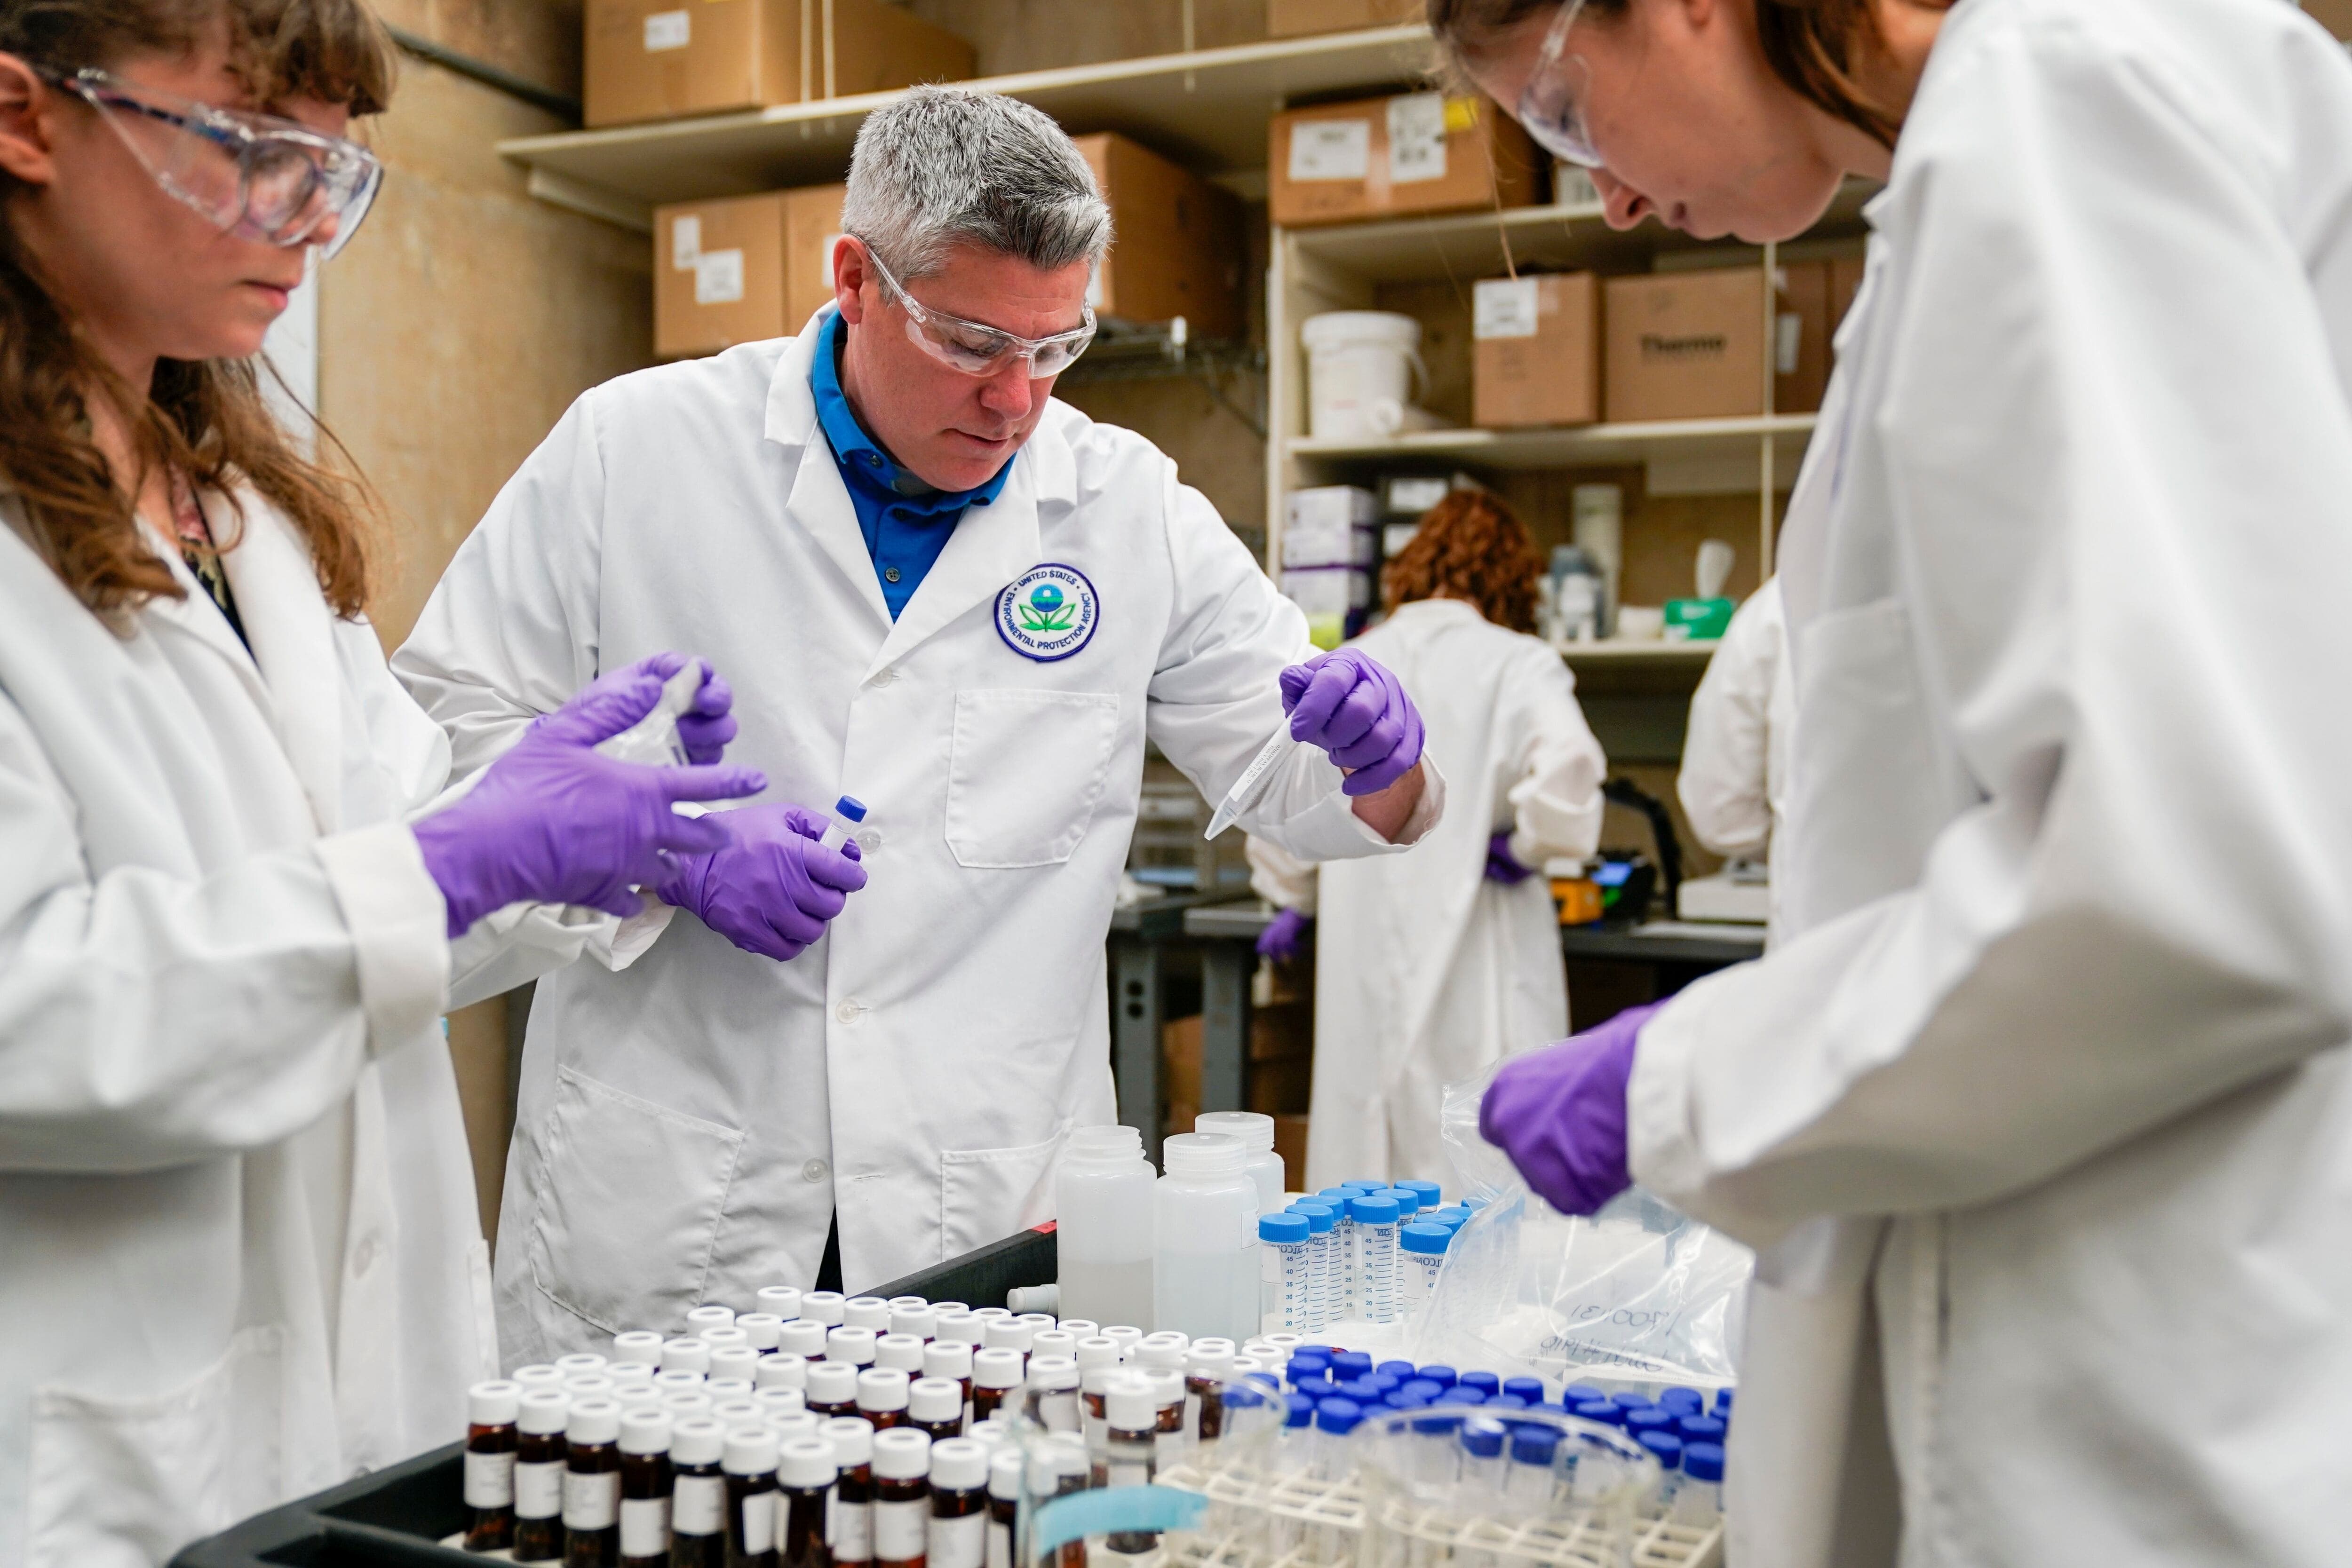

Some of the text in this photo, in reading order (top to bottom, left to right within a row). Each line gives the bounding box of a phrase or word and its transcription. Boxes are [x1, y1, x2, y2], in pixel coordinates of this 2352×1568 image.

[1018, 570, 1077, 586] UNITED STATES
[1003, 592, 1091, 649] ENVIRONMENTAL PROTECTION AGENCY
